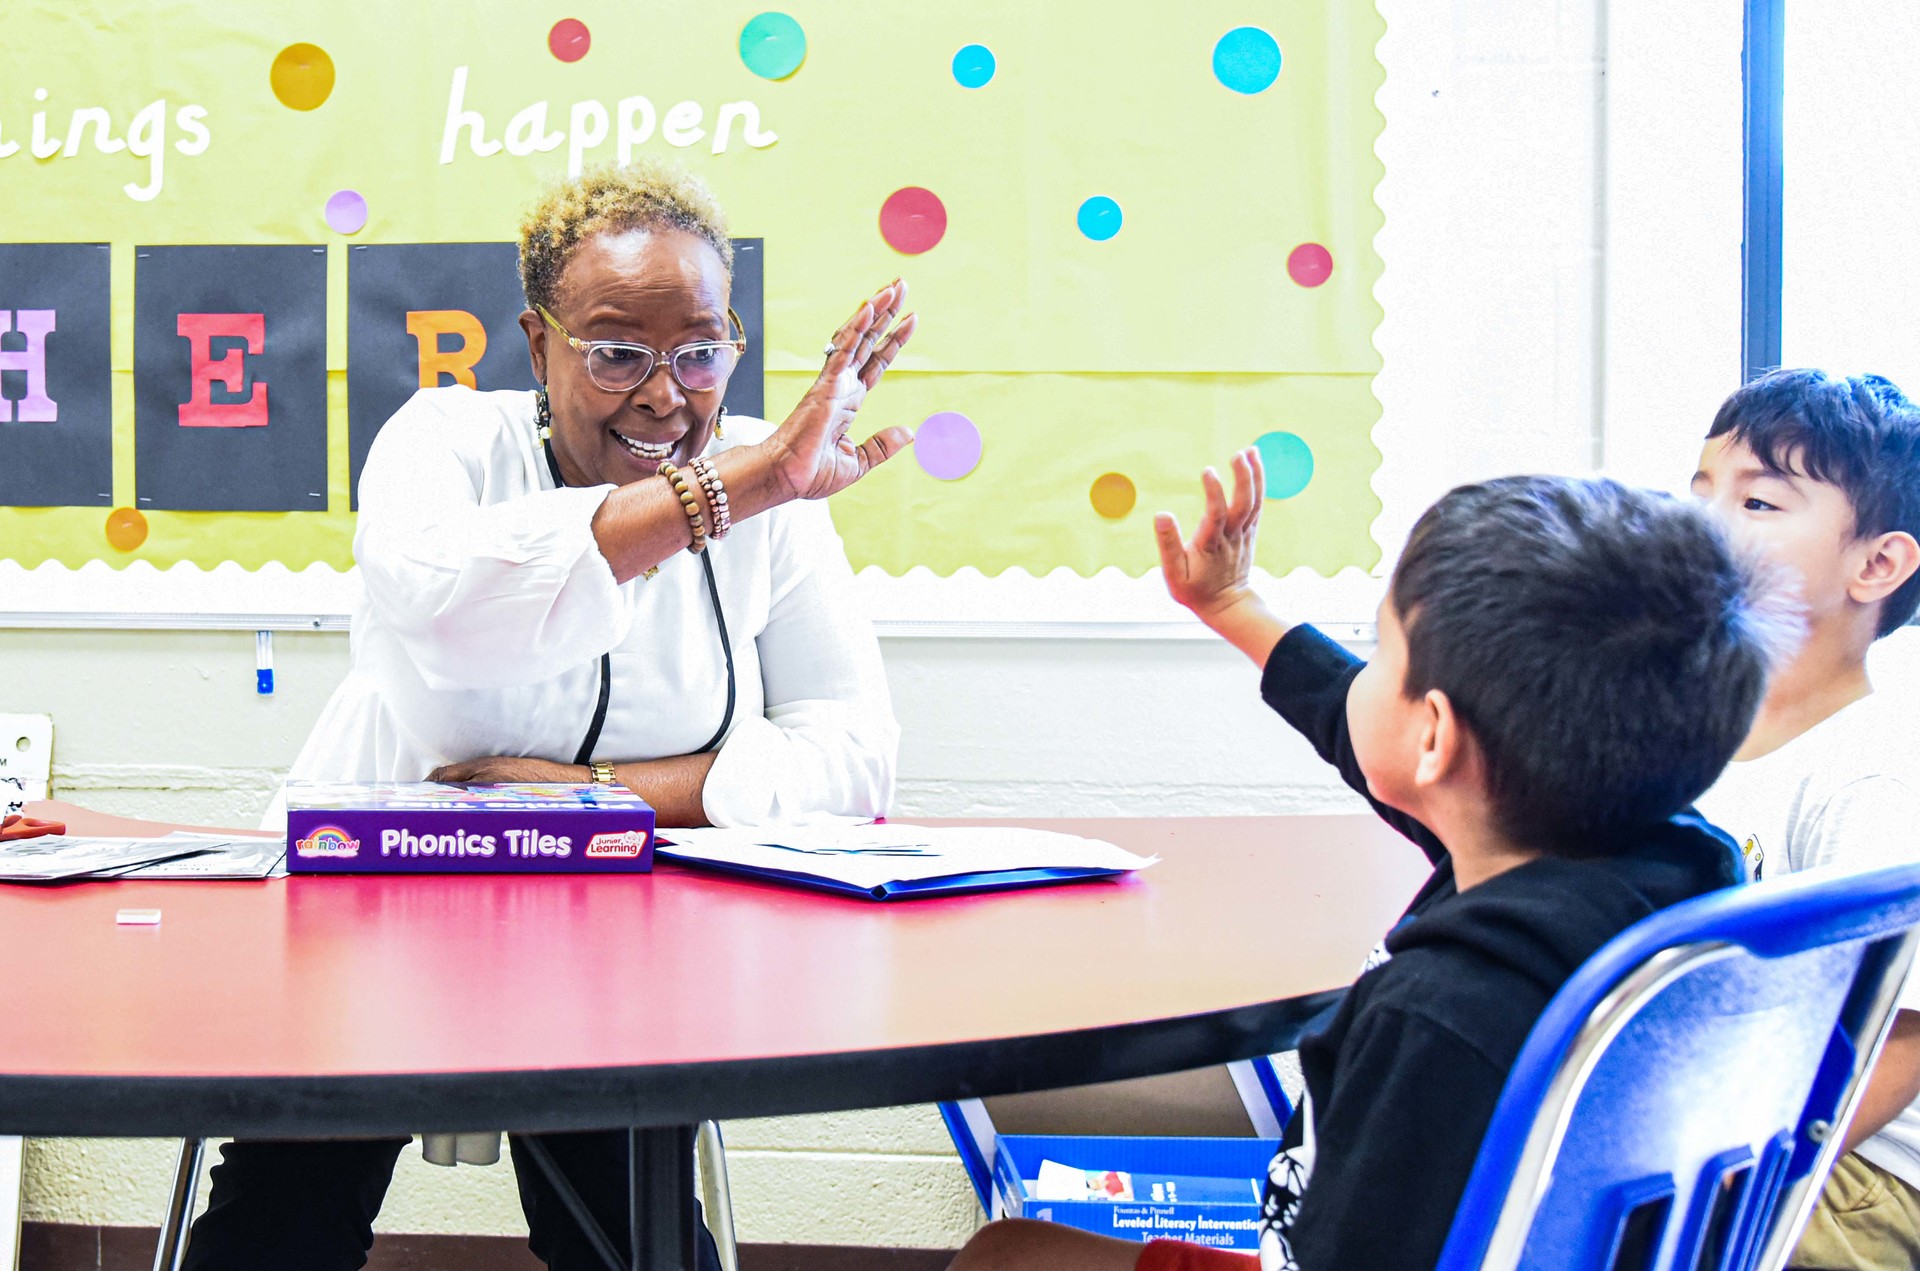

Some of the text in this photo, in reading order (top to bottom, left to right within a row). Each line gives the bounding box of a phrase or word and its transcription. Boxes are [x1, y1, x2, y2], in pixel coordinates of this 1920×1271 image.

[0, 66, 778, 202] ings happen
[296, 836, 360, 851] rainbow
[381, 829, 573, 857] Phonics Tiles
[591, 842, 637, 855] Learning
[596, 837, 622, 846] Junior
[1113, 1213, 1153, 1228] Leveled
[1155, 1214, 1197, 1231] Literacy
[1184, 1232, 1235, 1246] Materials
